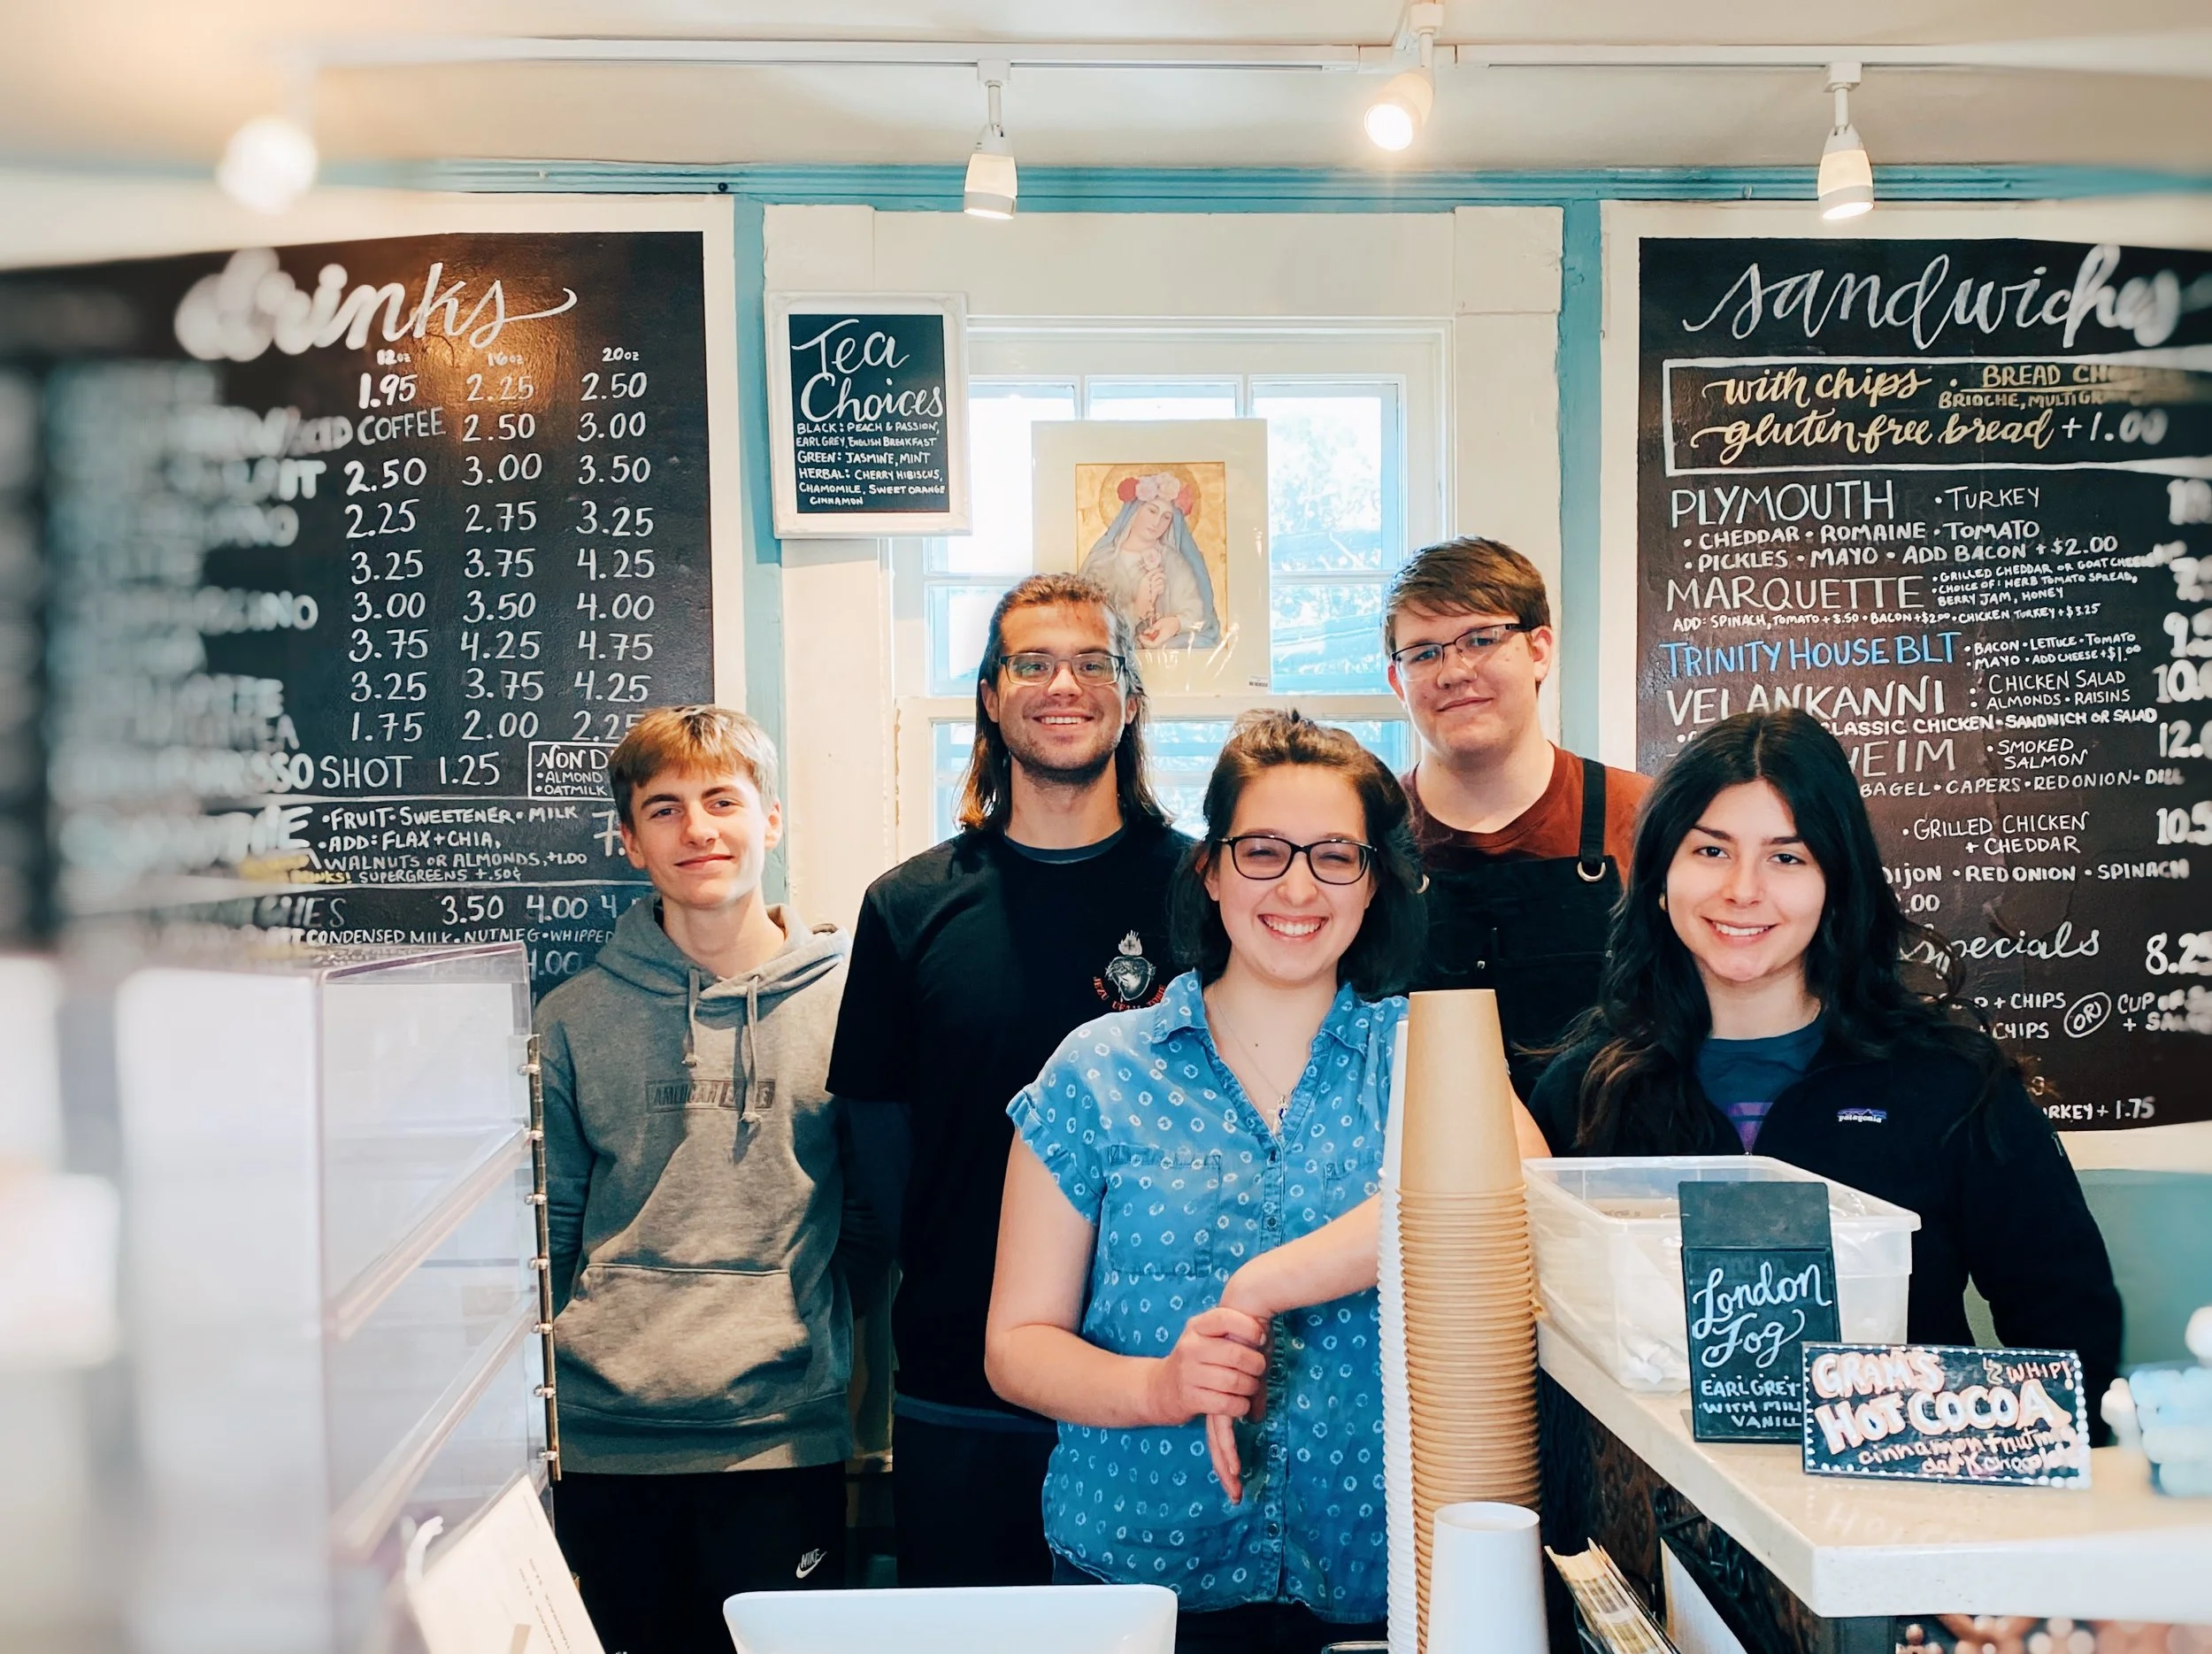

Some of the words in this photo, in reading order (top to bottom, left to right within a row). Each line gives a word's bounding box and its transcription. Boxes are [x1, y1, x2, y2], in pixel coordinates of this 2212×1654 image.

[791, 319, 910, 381] Tea
[358, 373, 419, 409] 1.95
[466, 373, 534, 402] 2.25
[580, 372, 648, 402] 2.50
[800, 372, 944, 422] Choices
[1701, 366, 1811, 408] with
[1815, 366, 1932, 408] chips
[1982, 365, 2062, 388] BREAD
[357, 408, 447, 446] COFFEE
[462, 413, 536, 442] 2.50
[576, 412, 647, 442] 3.00
[796, 422, 844, 435] BLACK:
[847, 422, 882, 433] PEACH
[1690, 408, 1860, 465] gluten
[1859, 413, 1933, 454] free
[1938, 408, 2055, 450] bread
[796, 436, 821, 448] EARL
[883, 436, 937, 448] BREAKFAST
[797, 450, 841, 464] GREEN:
[900, 452, 931, 464] MINT
[344, 458, 427, 496] 2.50
[462, 453, 542, 487] 3.00
[577, 455, 651, 485] 3.50
[798, 468, 850, 481] HERBAL:
[855, 469, 894, 481] CHERRY
[810, 496, 864, 505] CINNAMON
[868, 484, 907, 495] SWEET
[908, 485, 945, 495] ORANGE
[1671, 479, 1894, 528] PLYMOUTH
[1944, 486, 2040, 512] TURKEY
[344, 499, 420, 539] 2.25
[465, 501, 537, 534] 2.75
[576, 500, 655, 537] 3.25
[1699, 525, 1801, 550] CHEDDAR
[1820, 521, 1926, 544] ROMAINE
[1942, 519, 2040, 541] TOMATO
[351, 550, 424, 585] 3.25
[464, 549, 536, 579] 3.75
[577, 549, 656, 581] 4.25
[1698, 550, 1789, 573] PICKLES
[1810, 546, 1879, 569] MAYO
[1902, 545, 1947, 565] ADD
[1954, 543, 2027, 563] BACON
[1666, 575, 1924, 612] MARQUETTE
[1939, 569, 1993, 582] GRILLED
[1995, 564, 2054, 577] CHEDDAR
[2056, 562, 2074, 572] OR
[2077, 558, 2110, 570] GOAT
[1937, 595, 1976, 608] BERRY
[2022, 586, 2064, 601] HONEY
[1939, 582, 1979, 595] CHOICE
[2004, 576, 2039, 588] HERB
[2041, 574, 2086, 585] TOMATO
[351, 591, 426, 623] 3.00
[463, 589, 536, 623] 3.50
[577, 593, 655, 621] 4.00
[1772, 613, 1820, 626] TOMATO
[1870, 611, 1912, 624] BACON
[1958, 609, 2010, 625] CHICKEN
[2013, 605, 2055, 620] TURKEY
[349, 628, 429, 663] 3.75
[461, 630, 542, 662] 4.25
[578, 630, 654, 661] 4.75
[1659, 639, 1781, 679] TRINITY
[1789, 636, 1890, 672] HOUSE
[1893, 631, 1962, 665] BLT
[1973, 640, 2020, 656] BACON
[2030, 635, 2078, 651] LETTUCE
[2085, 632, 2136, 646] TOMATO
[1974, 655, 2020, 671] MAYO
[2032, 652, 2056, 665] ADD
[2057, 650, 2098, 663] CHEESE
[350, 671, 427, 703] 3.25
[465, 667, 545, 702] 3.75
[574, 670, 652, 704] 4.25
[1666, 674, 1945, 726] VELANKANNI
[1988, 671, 2070, 695] CHICKEN
[2076, 669, 2126, 687] SALAD
[1986, 693, 2062, 711] ALMONDS
[2075, 689, 2131, 705] RAISINS
[351, 712, 426, 742] 1.75
[461, 710, 539, 742] 2.00
[1913, 713, 1994, 734] CHICKEN
[2090, 710, 2110, 723] OR
[2112, 707, 2158, 723] SALAD
[535, 744, 588, 770] NON
[1996, 737, 2075, 756] SMOKED
[2004, 749, 2088, 770] SALMON
[319, 755, 412, 789] SHOT
[440, 751, 501, 787] 1.25
[545, 772, 603, 784] ALMOND
[543, 785, 608, 796] OATMILK
[1861, 781, 1932, 798] BAGEL
[1946, 777, 2022, 795] CAPERS
[329, 807, 388, 831] FRUIT
[400, 806, 515, 827] SWEETENER
[529, 806, 578, 822] MILK
[1913, 817, 1993, 841] GRILLED
[2001, 810, 2090, 835] CHICKEN
[1984, 835, 2081, 856] CHEDDAR
[324, 855, 419, 871] WALNUTS
[426, 854, 449, 867] OR
[2097, 858, 2190, 881] SPINACH
[358, 870, 467, 883] SUPERGREENS
[441, 895, 504, 925] 3.50
[526, 896, 588, 922] 4.00
[306, 929, 405, 945] CONDENSED
[410, 930, 453, 944] MILK
[464, 928, 539, 943] NUTMEG
[2009, 992, 2067, 1010] CHIPS
[2117, 992, 2155, 1014] CUP
[1838, 1114, 1882, 1124] patagonia
[1691, 1261, 1832, 1339] London
[1701, 1309, 1805, 1368] Fog
[1701, 1373, 1749, 1397] EARL
[1703, 1400, 1758, 1414] WITH
[1815, 1391, 1906, 1455] HOT
[1907, 1378, 2073, 1435] COCOA
[1858, 1435, 1986, 1465] cinnamon
